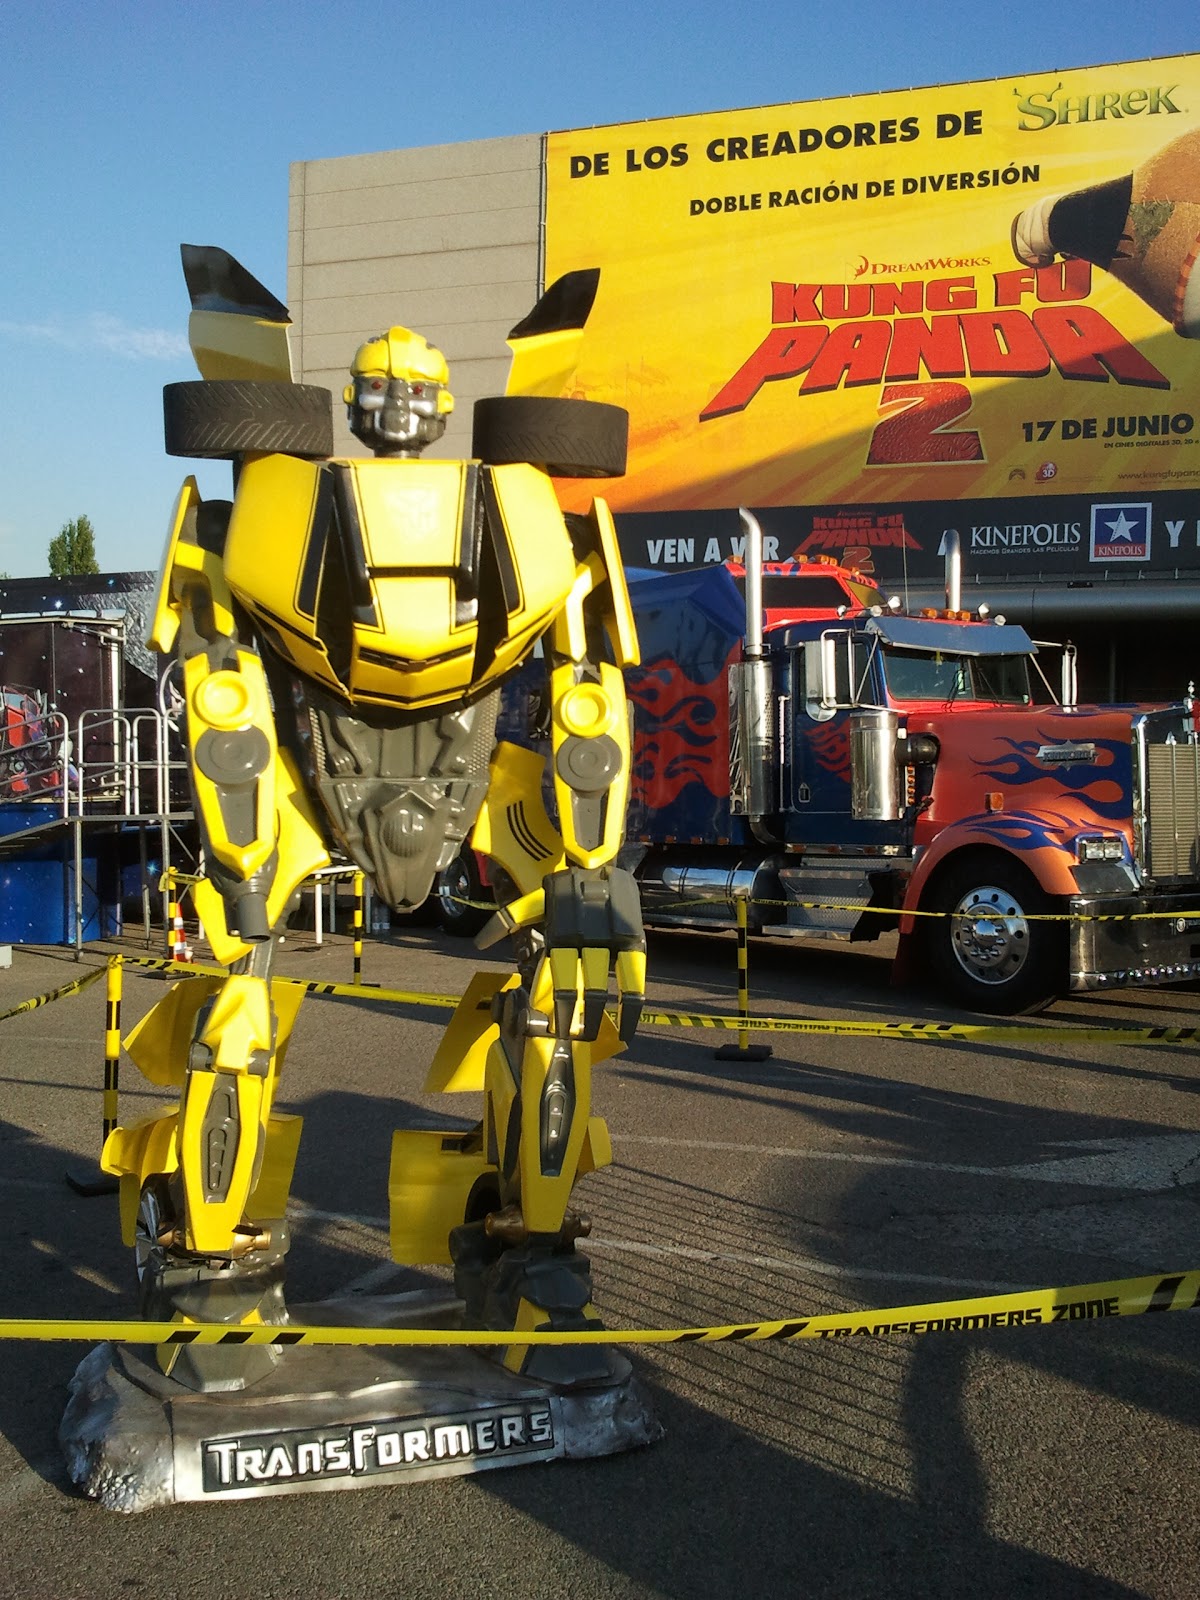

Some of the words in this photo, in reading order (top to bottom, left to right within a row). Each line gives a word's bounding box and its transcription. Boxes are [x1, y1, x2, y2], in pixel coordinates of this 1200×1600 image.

[570, 152, 610, 179] DE
[626, 143, 689, 172] LOS
[706, 116, 920, 163] CREADORES
[936, 109, 983, 139] DE
[690, 193, 762, 216] DOBLE
[768, 180, 858, 208] RACIÓN
[866, 180, 895, 199] DE
[902, 162, 1040, 195] DIVERSIÓN
[771, 275, 978, 324] KUNG
[993, 257, 1092, 307] FU
[699, 305, 1171, 423] PANDA
[863, 381, 987, 466] 2
[1022, 420, 1057, 443] 17
[1061, 418, 1097, 440] DE
[1102, 413, 1195, 438] JUNIO
[1042, 469, 1055, 478] 3D
[813, 516, 871, 529] KUNG
[877, 513, 904, 528] FU
[970, 522, 1081, 547] KINEPOLIS
[1164, 520, 1186, 548] Y
[647, 538, 695, 564] VEN
[704, 538, 721, 562] A
[730, 536, 779, 562] VR
[793, 526, 923, 556] PANDA
[1098, 545, 1142, 556] KINEPOLIS
[841, 546, 875, 574] 2
[814, 1307, 1042, 1338] TRANSFORMERS
[1052, 1296, 1120, 1322] ZONE
[206, 1411, 551, 1485] TRANSFORMERS
